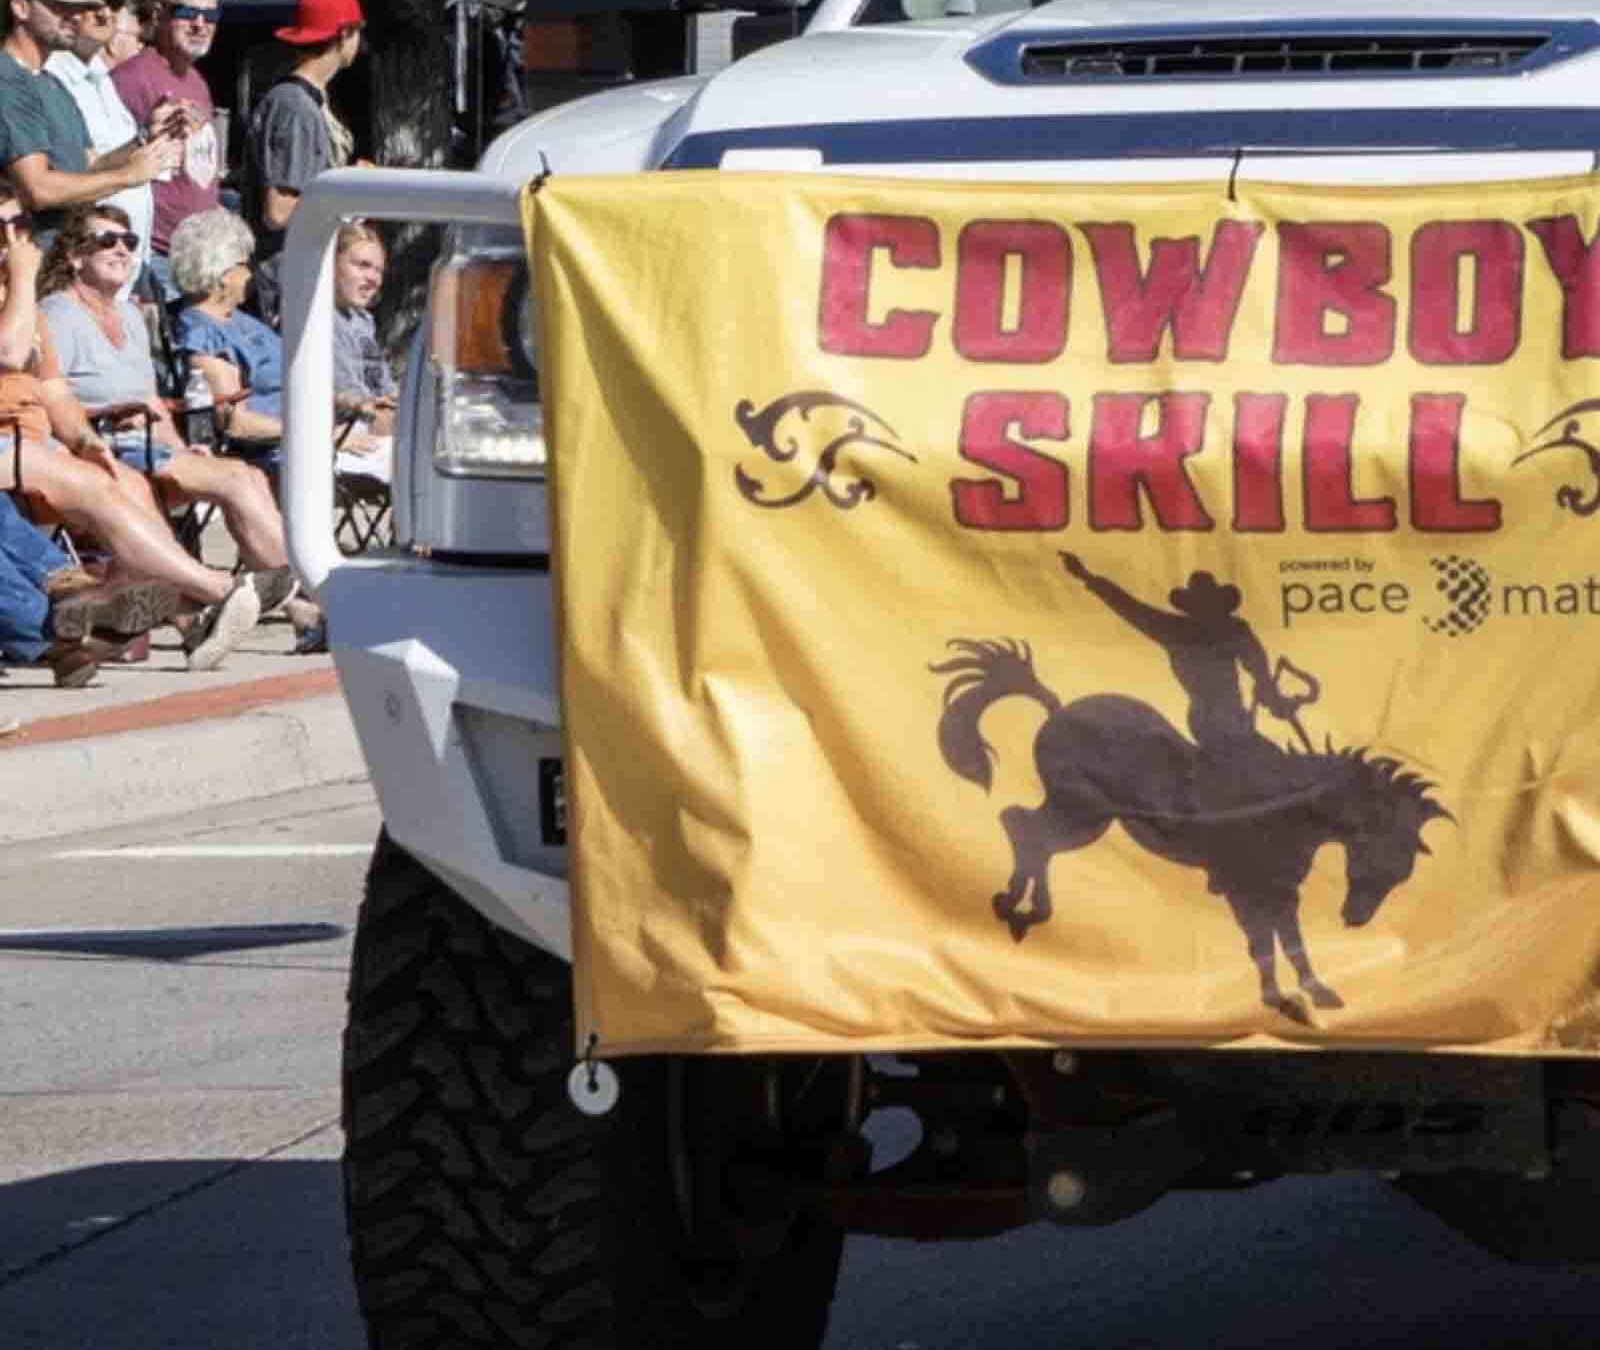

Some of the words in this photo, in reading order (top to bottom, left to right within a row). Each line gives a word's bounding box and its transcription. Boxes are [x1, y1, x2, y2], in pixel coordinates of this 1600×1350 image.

[948, 389, 1504, 534] SKILL
[1278, 557, 1350, 574] powered
[1353, 557, 1377, 574] by
[1279, 580, 1410, 628] pace
